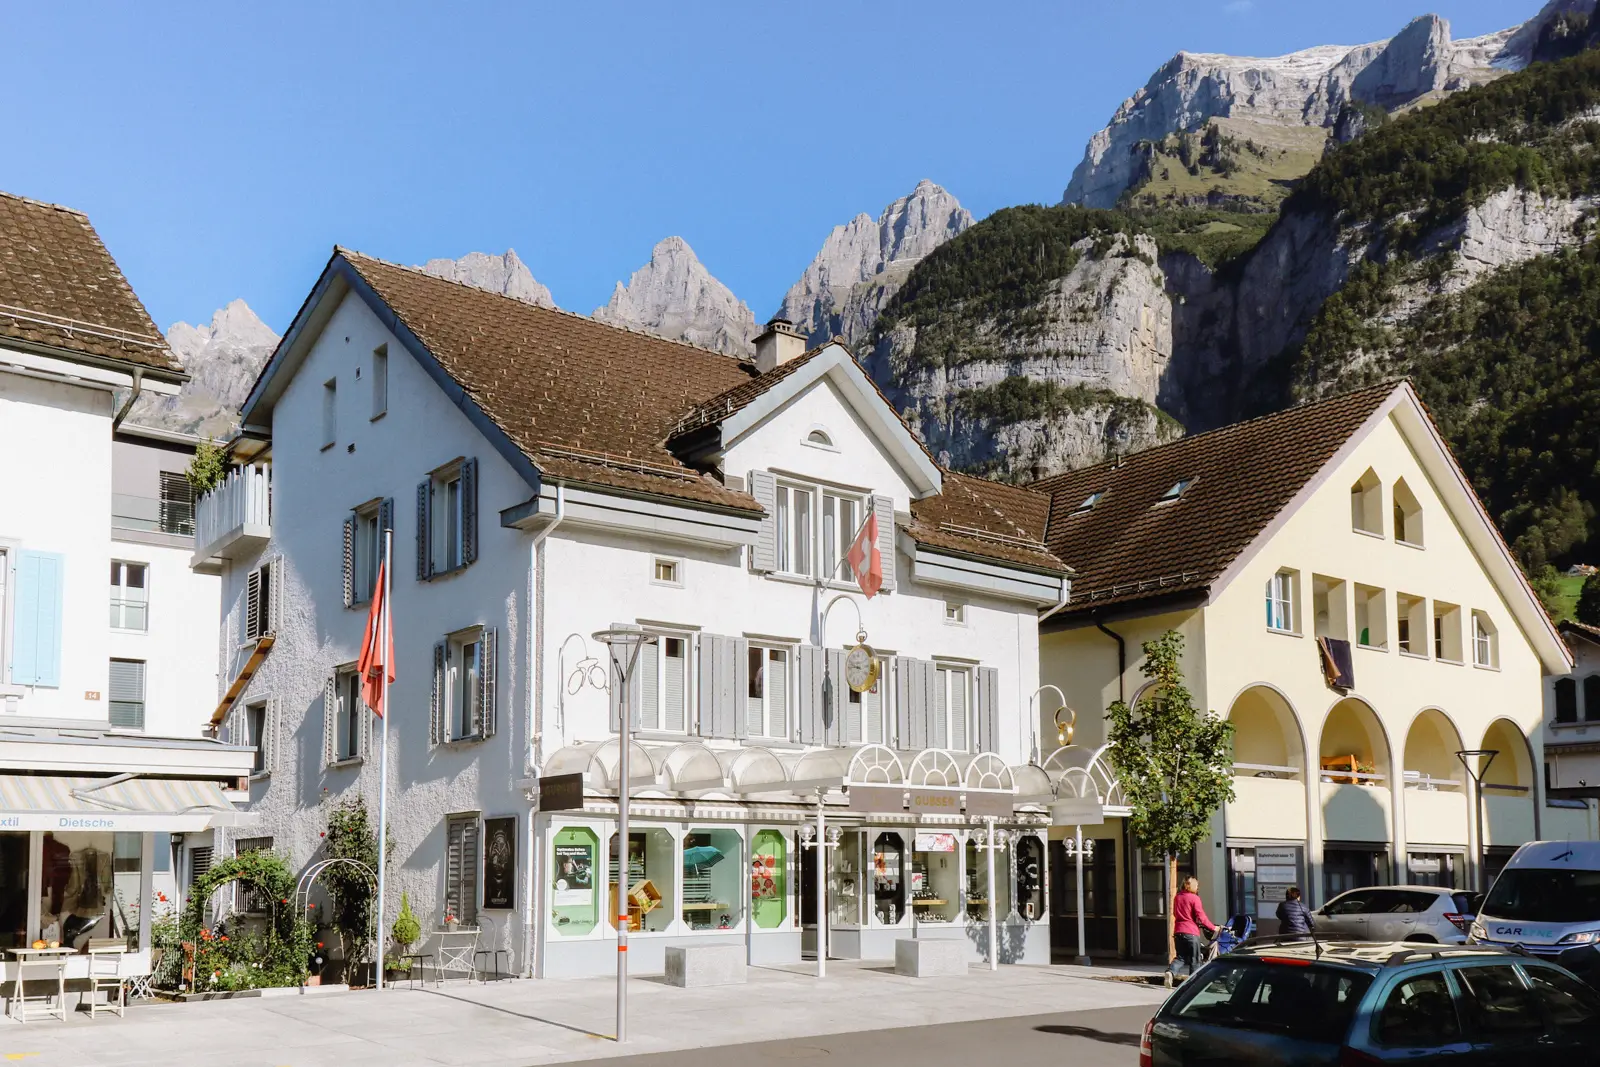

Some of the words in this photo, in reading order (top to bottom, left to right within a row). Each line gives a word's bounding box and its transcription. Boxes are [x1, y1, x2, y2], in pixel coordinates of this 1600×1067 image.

[915, 795, 955, 806] GUBSER
[0, 817, 19, 827] xtil
[59, 817, 114, 827] Dietsche
[1496, 926, 1553, 938] CARLYNE
